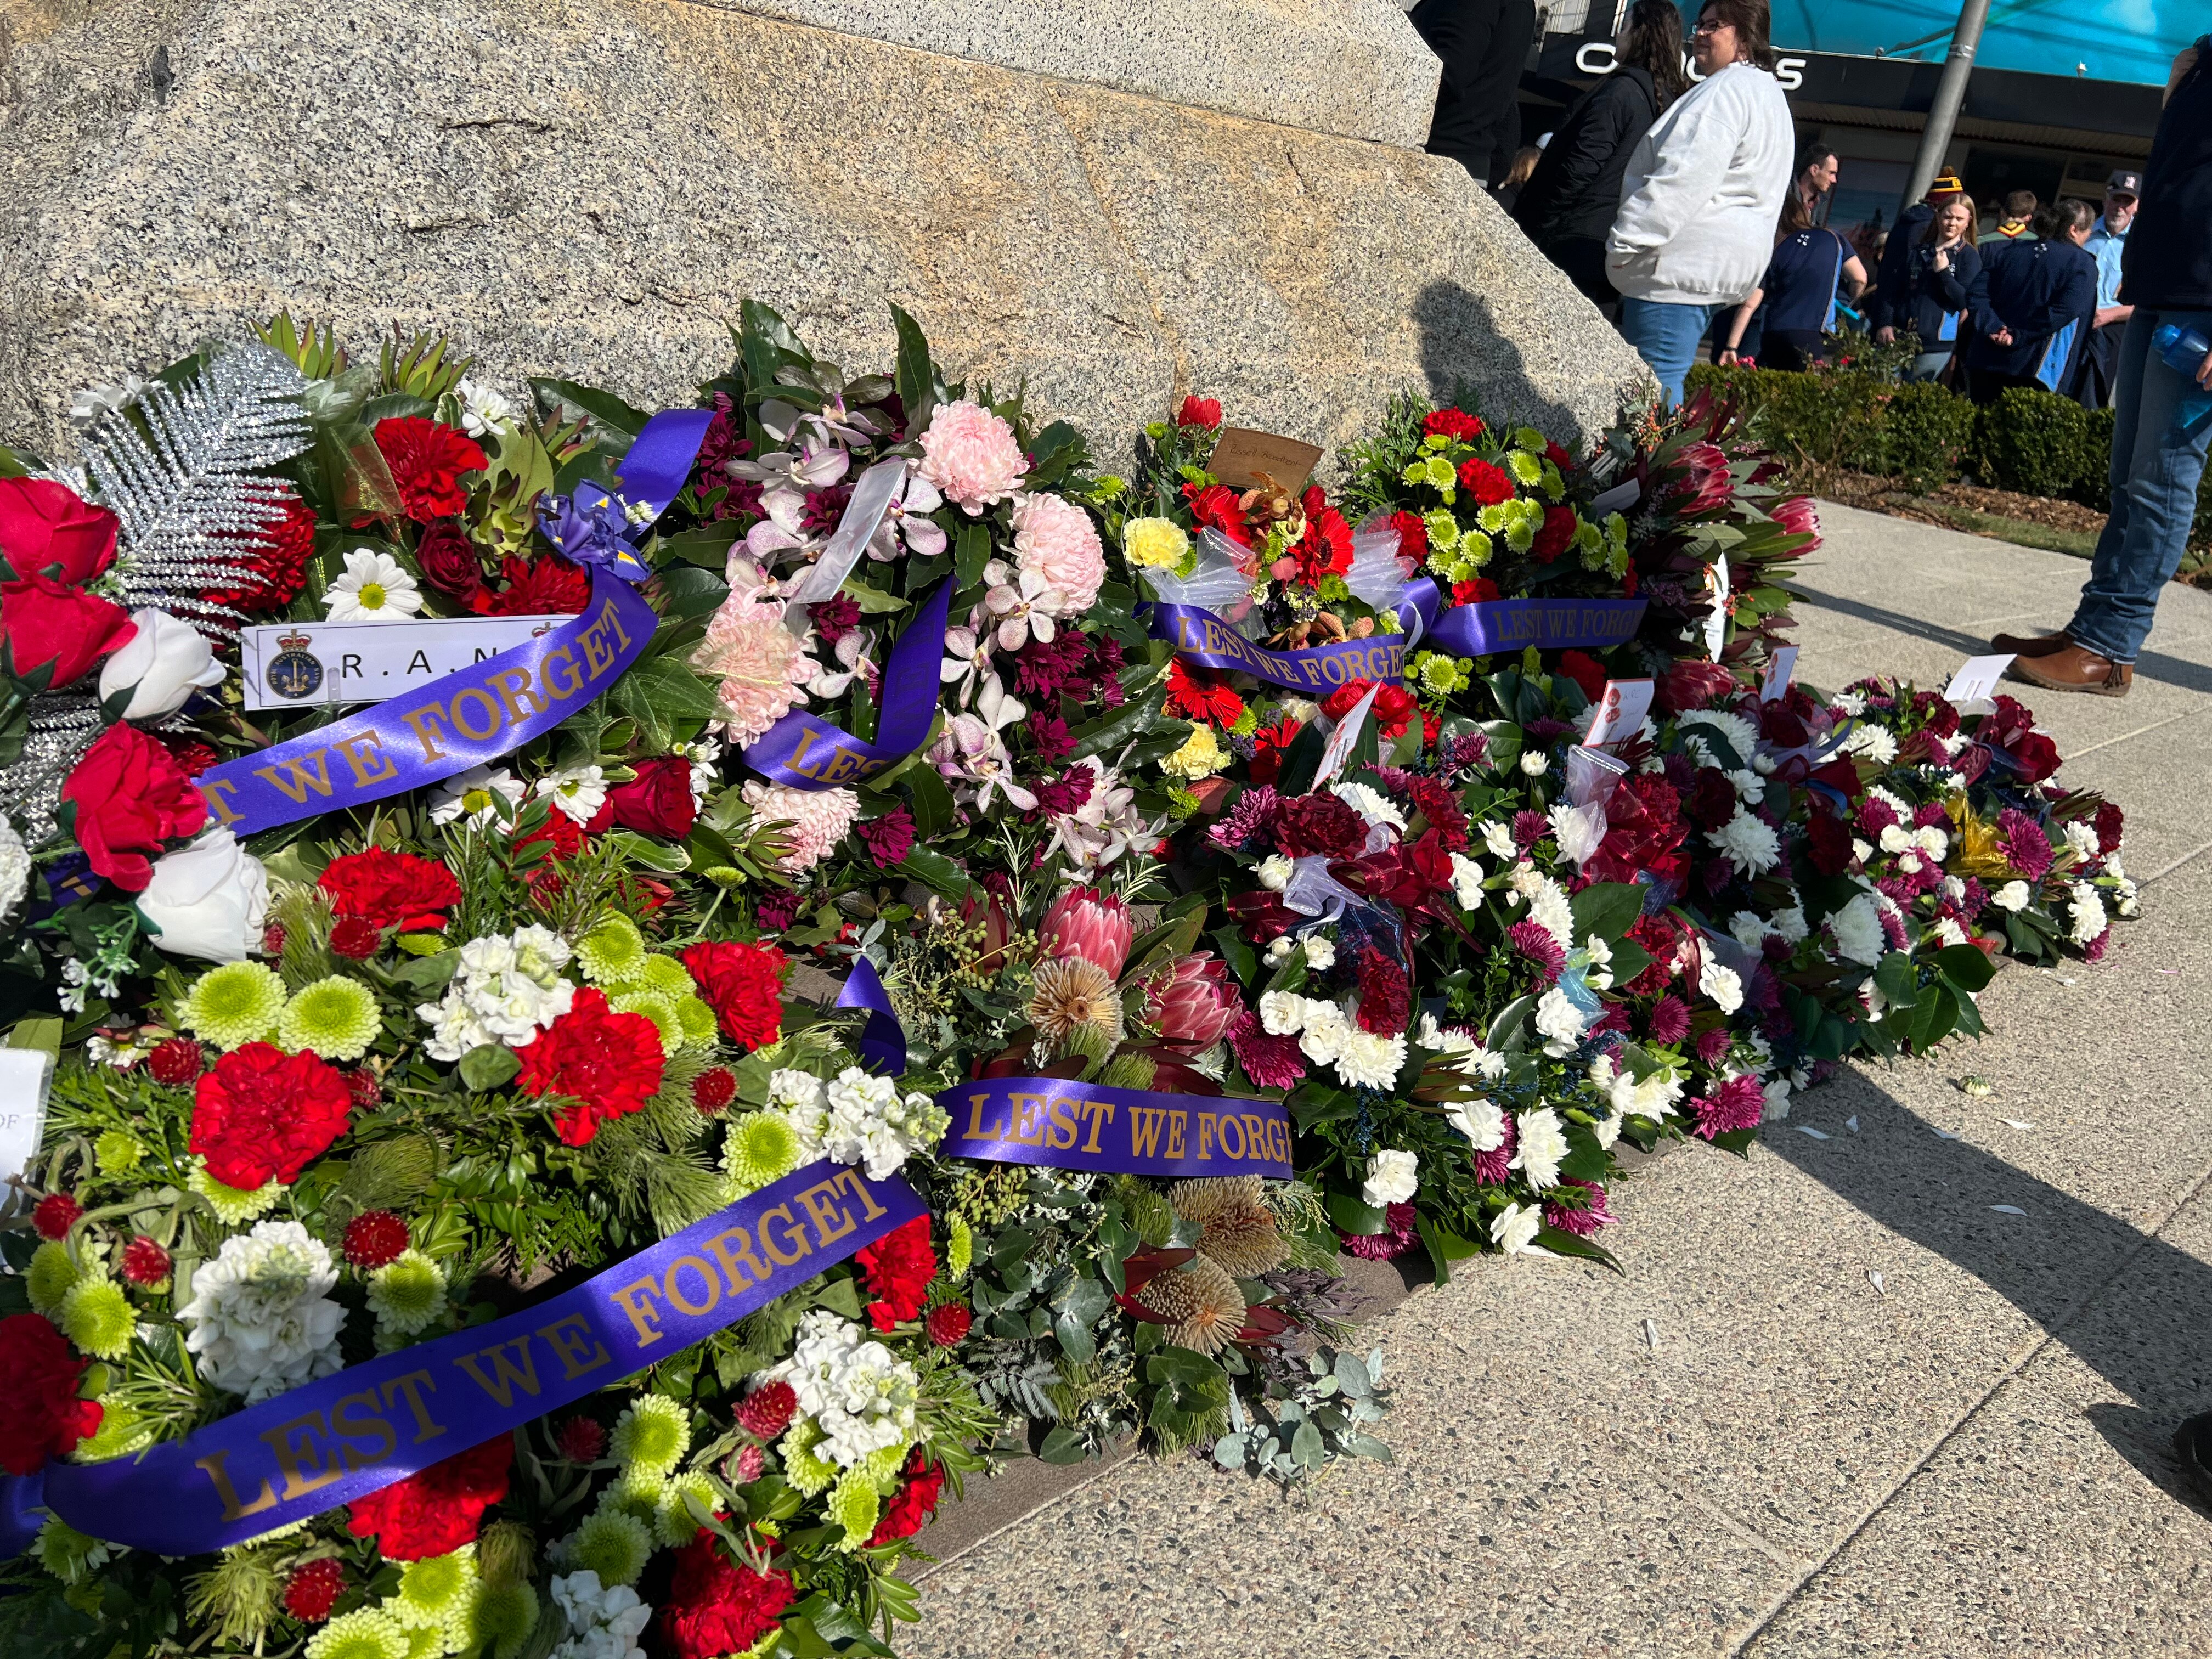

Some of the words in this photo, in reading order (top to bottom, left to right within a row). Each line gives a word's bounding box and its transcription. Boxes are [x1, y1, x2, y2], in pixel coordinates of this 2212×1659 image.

[1229, 443, 1258, 458] Russell
[1176, 616, 1254, 664] LEST
[1248, 646, 1302, 684] WE
[1493, 608, 1542, 641] LEST
[1547, 609, 1577, 639] WE
[275, 653, 316, 665] AUSTRALIAN
[252, 729, 398, 803] WE
[401, 597, 633, 765] FORGET
[962, 1092, 1115, 1154] LEST
[1128, 1106, 1187, 1159] WE
[195, 1368, 447, 1522] LEST
[453, 1313, 613, 1408] WE
[610, 1168, 888, 1348] FORGET
